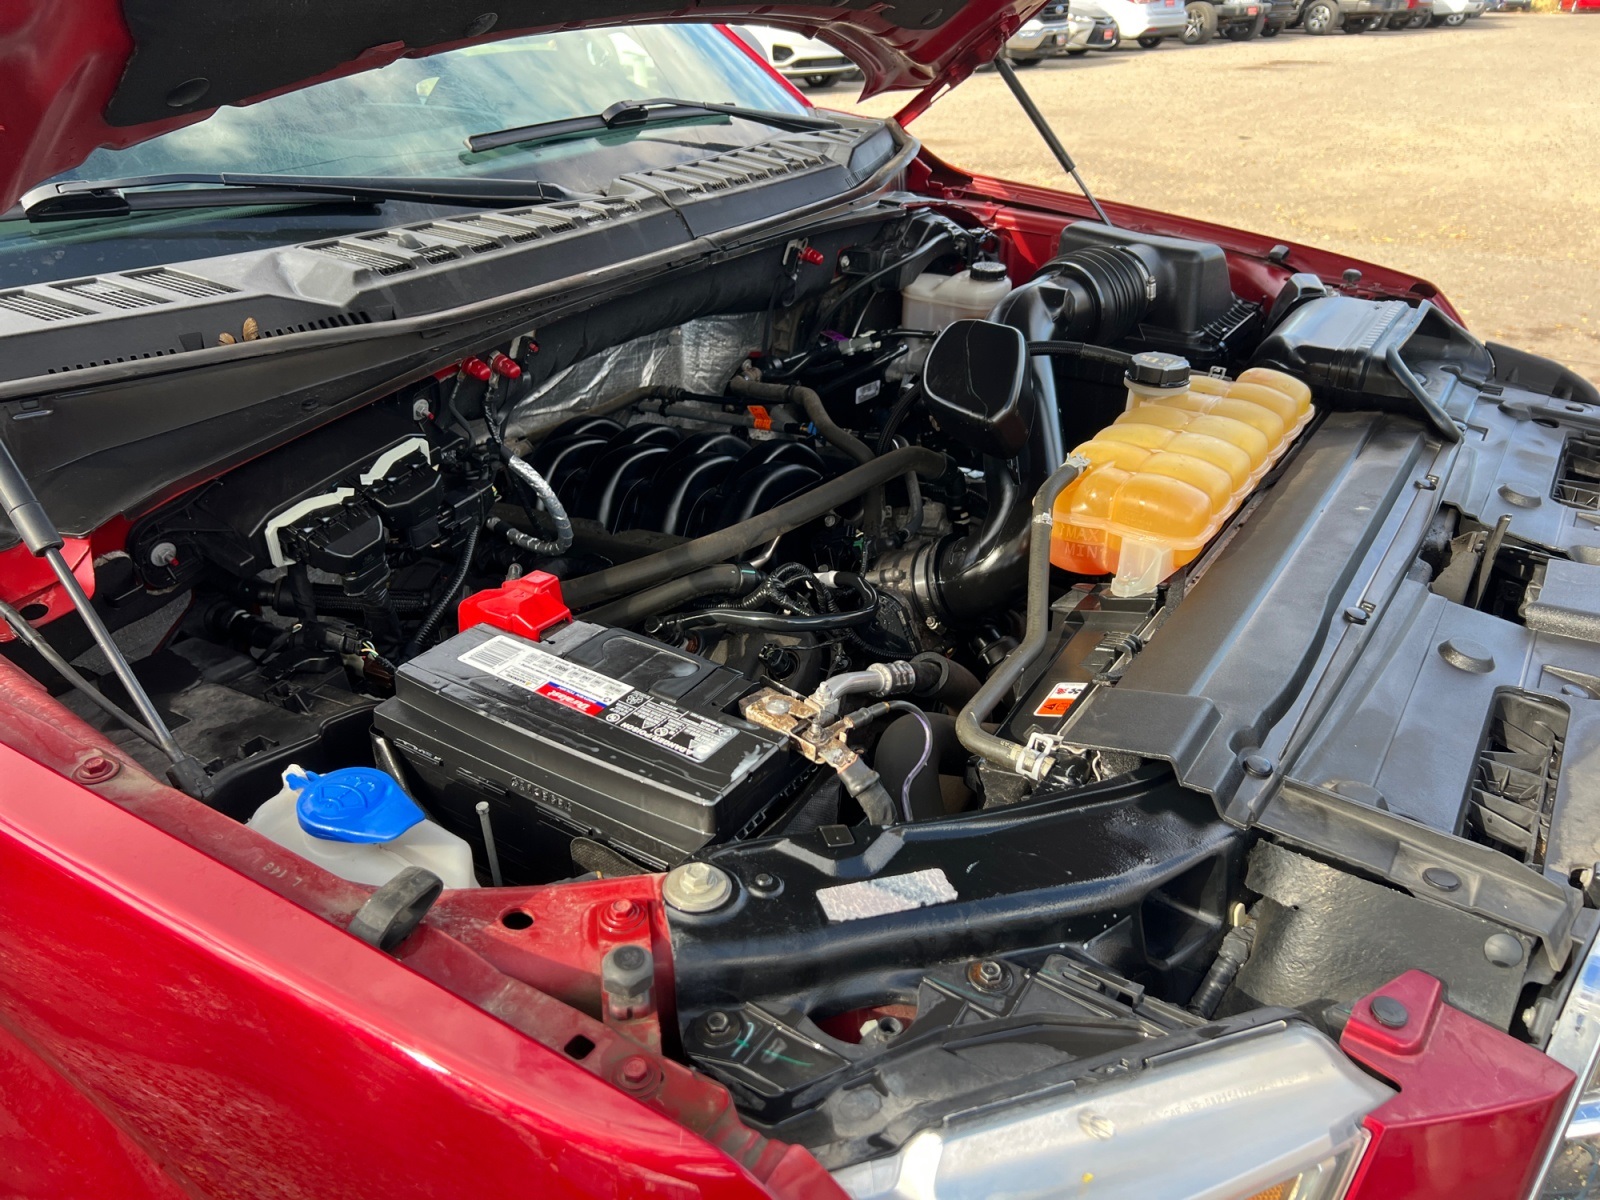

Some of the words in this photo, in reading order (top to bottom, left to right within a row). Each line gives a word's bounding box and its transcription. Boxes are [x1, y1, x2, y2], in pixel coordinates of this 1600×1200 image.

[1066, 525, 1100, 542] MAX
[1064, 541, 1099, 559] MIN
[546, 689, 591, 712] Duralast
